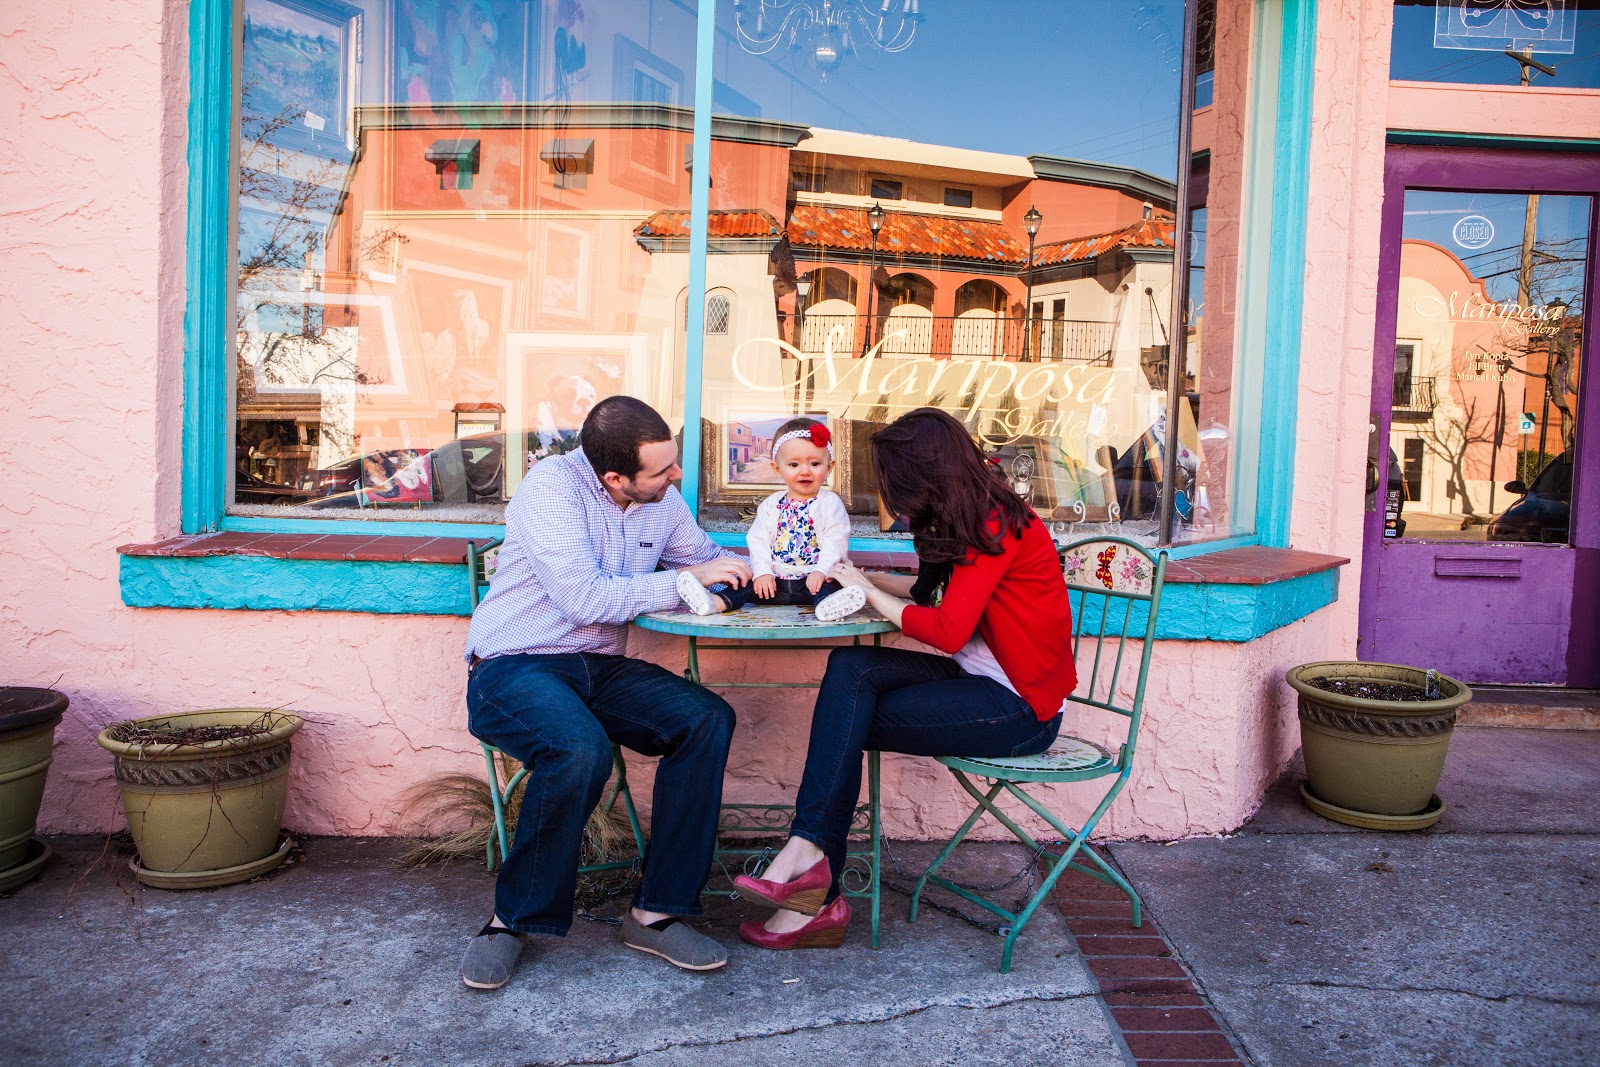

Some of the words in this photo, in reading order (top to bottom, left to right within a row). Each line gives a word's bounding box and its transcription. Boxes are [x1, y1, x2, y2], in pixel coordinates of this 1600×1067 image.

[1460, 225, 1489, 240] CLOSED
[1415, 291, 1567, 328] Mariposa
[1506, 322, 1560, 337] Gallery
[1465, 351, 1480, 361] Lyn
[1483, 352, 1509, 361] Kopta
[731, 324, 1128, 422] Mariposa
[1467, 362, 1481, 371] Jill
[1483, 362, 1505, 371] Brett
[1491, 374, 1515, 382] Kuhn
